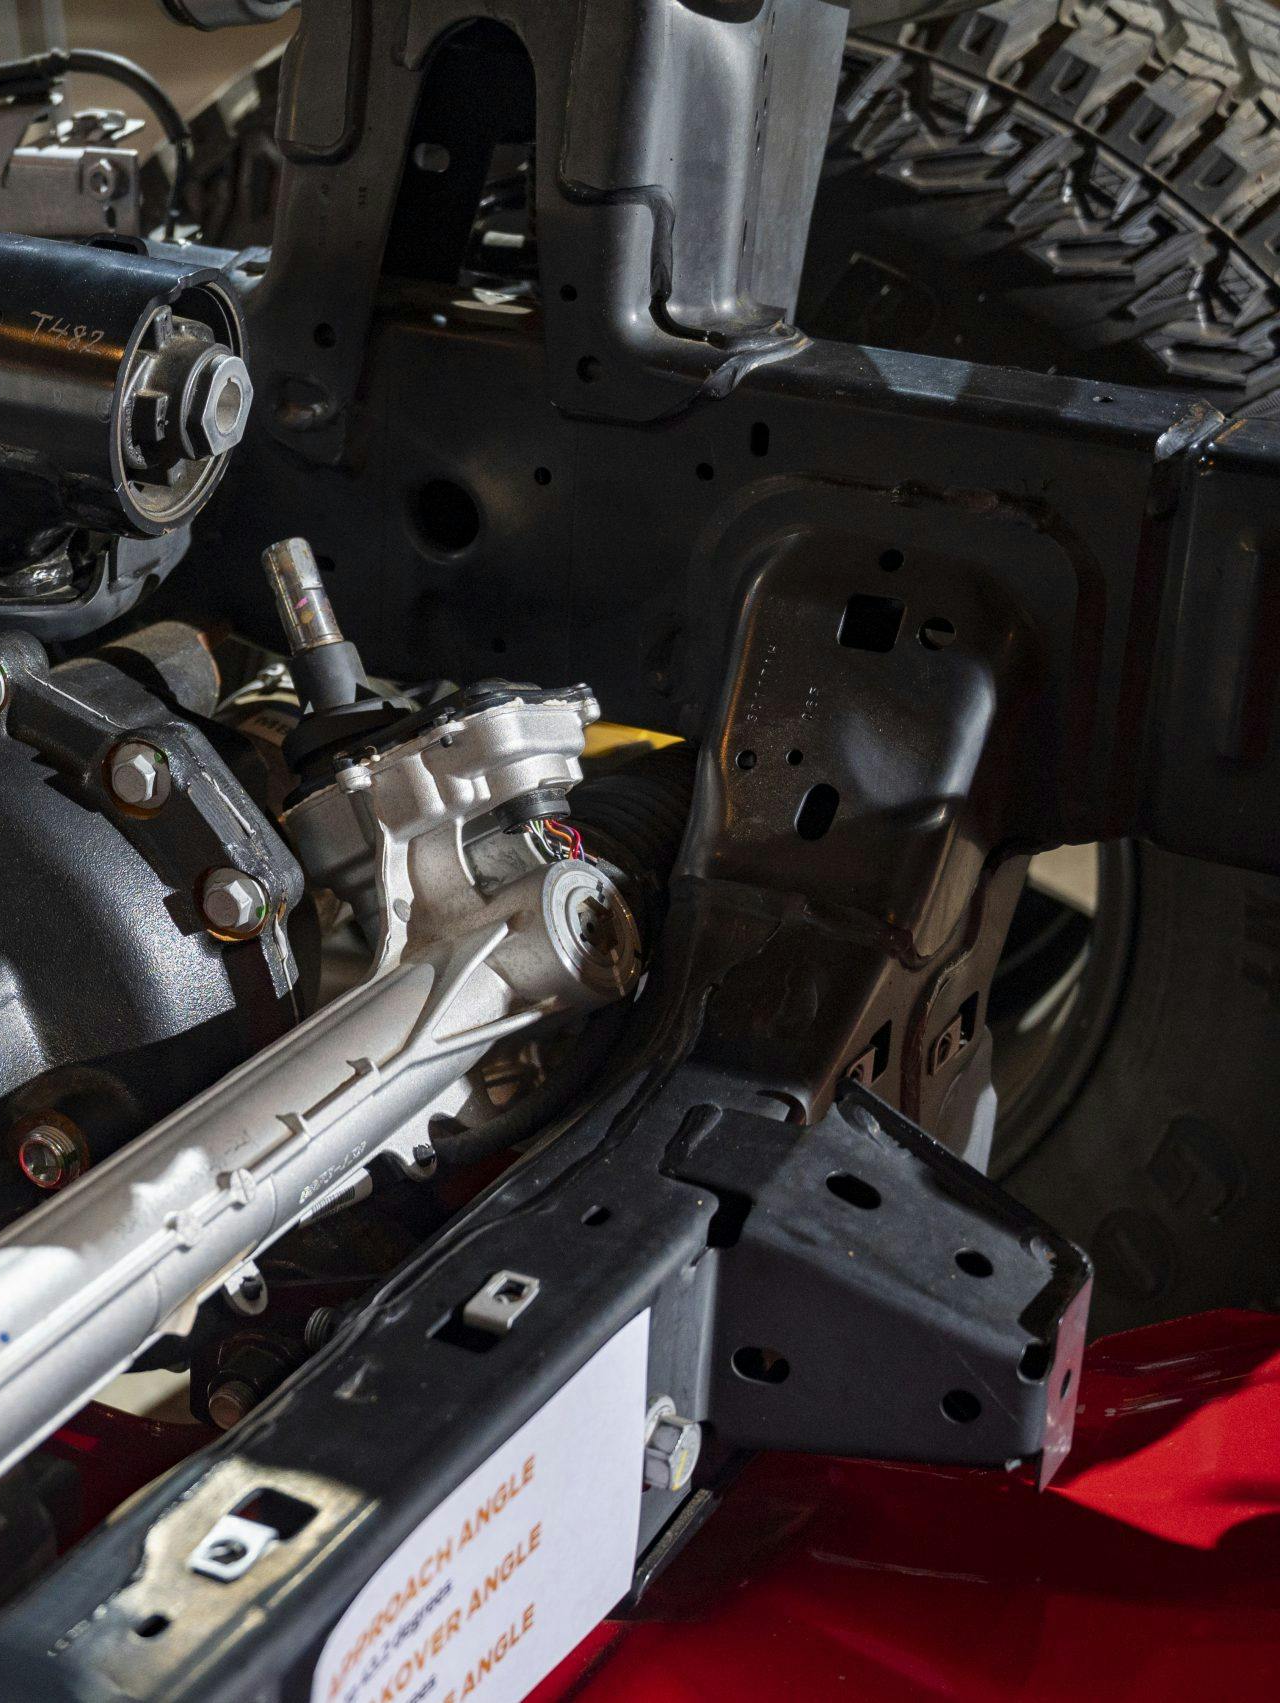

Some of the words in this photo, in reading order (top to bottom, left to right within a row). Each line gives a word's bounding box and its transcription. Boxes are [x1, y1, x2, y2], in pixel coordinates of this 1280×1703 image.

[30, 310, 105, 356] T482
[457, 1453, 535, 1553] ANGLE
[393, 1577, 453, 1649] degrees
[467, 1520, 542, 1619] ANGLE
[461, 1603, 535, 1701] ANGLE
